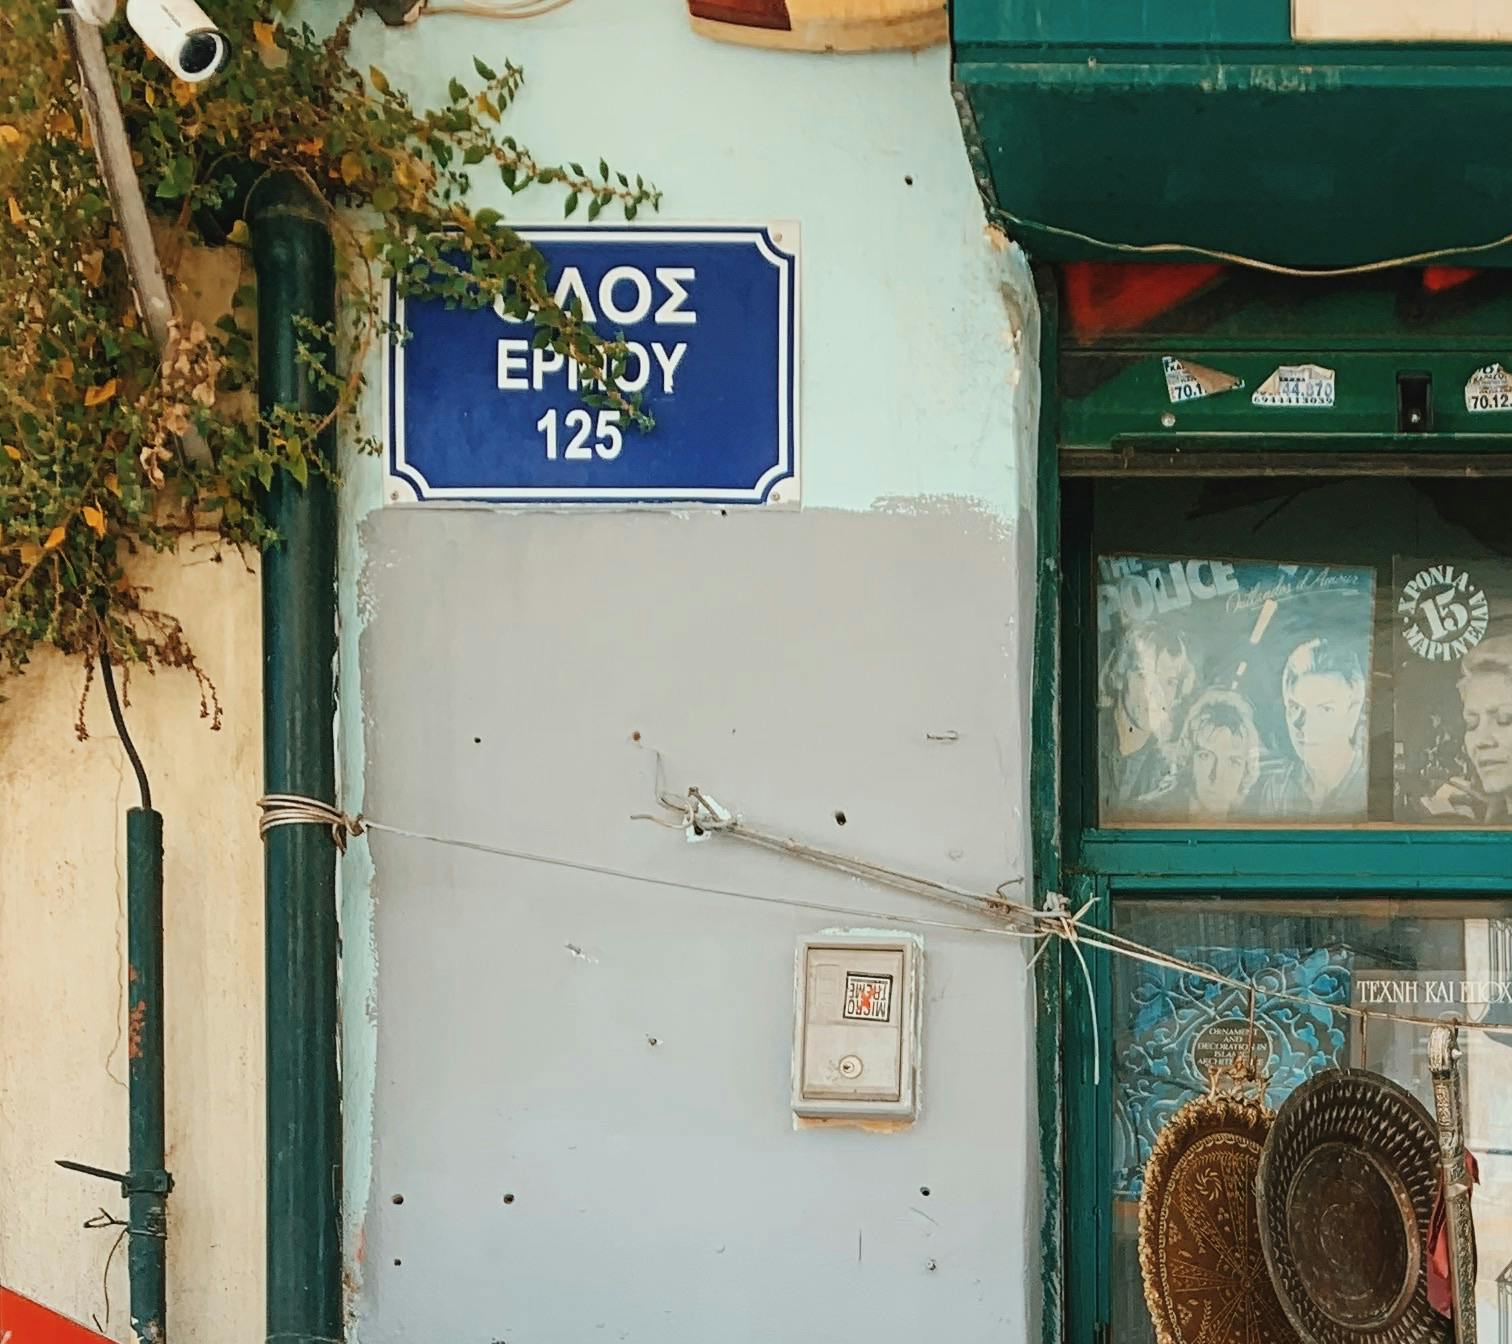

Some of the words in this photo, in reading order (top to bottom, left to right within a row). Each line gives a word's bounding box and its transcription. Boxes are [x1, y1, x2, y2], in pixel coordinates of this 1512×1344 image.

[536, 408, 623, 460] 125
[1099, 559, 1240, 632] POLICE
[1419, 587, 1469, 640] 15
[1356, 979, 1418, 1004] ΤΕΧΝΗ
[1425, 979, 1454, 1004] ΚΑΙ
[1223, 1035, 1243, 1043] AND
